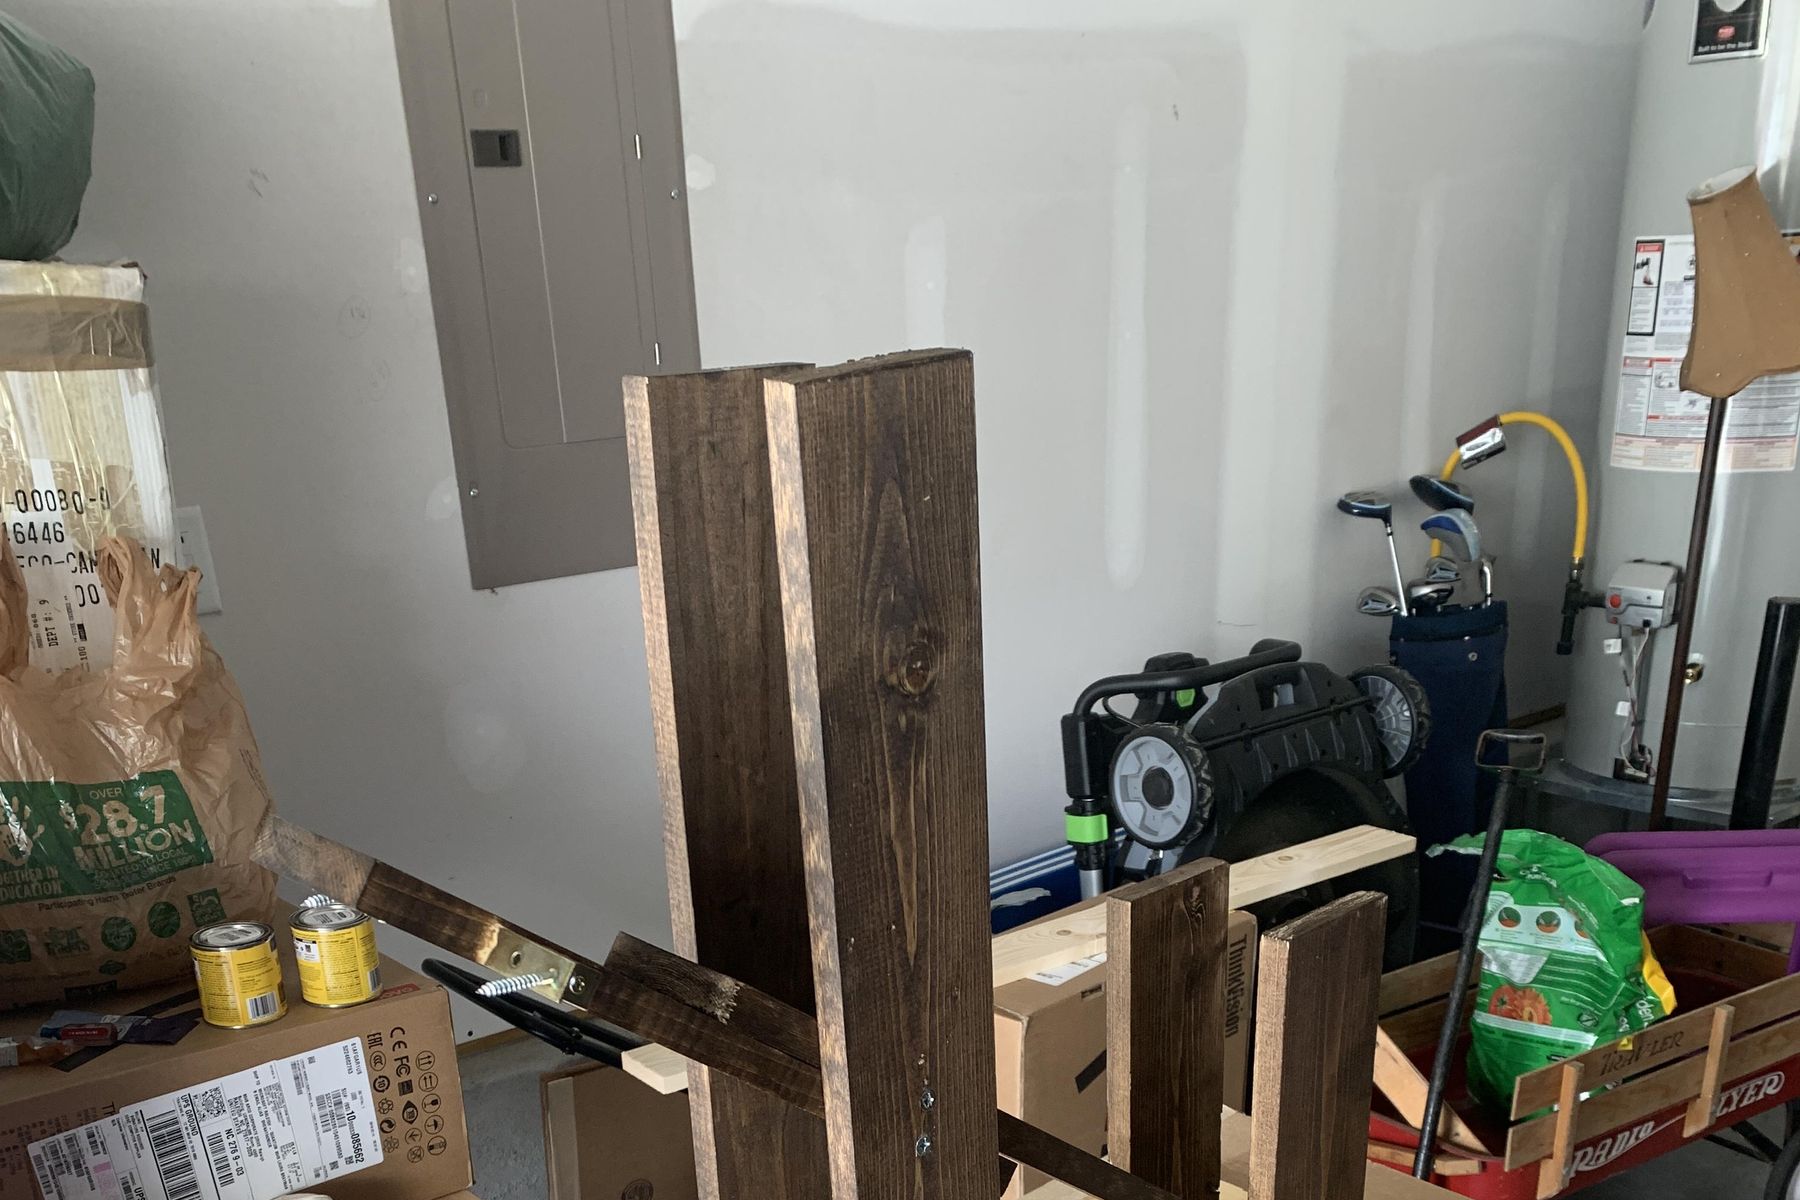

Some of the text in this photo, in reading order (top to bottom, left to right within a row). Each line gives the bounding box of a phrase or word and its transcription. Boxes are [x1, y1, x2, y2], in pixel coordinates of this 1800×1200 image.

[45, 626, 59, 647] DEPT
[89, 786, 123, 801] OVER
[72, 818, 196, 873] MILLION
[0, 867, 46, 885] OGETHER
[0, 880, 63, 901] DUCATION
[180, 1093, 190, 1108] UPS
[1716, 1071, 1785, 1117] LYER
[184, 1108, 198, 1137] GROUND
[224, 1127, 233, 1139] NC
